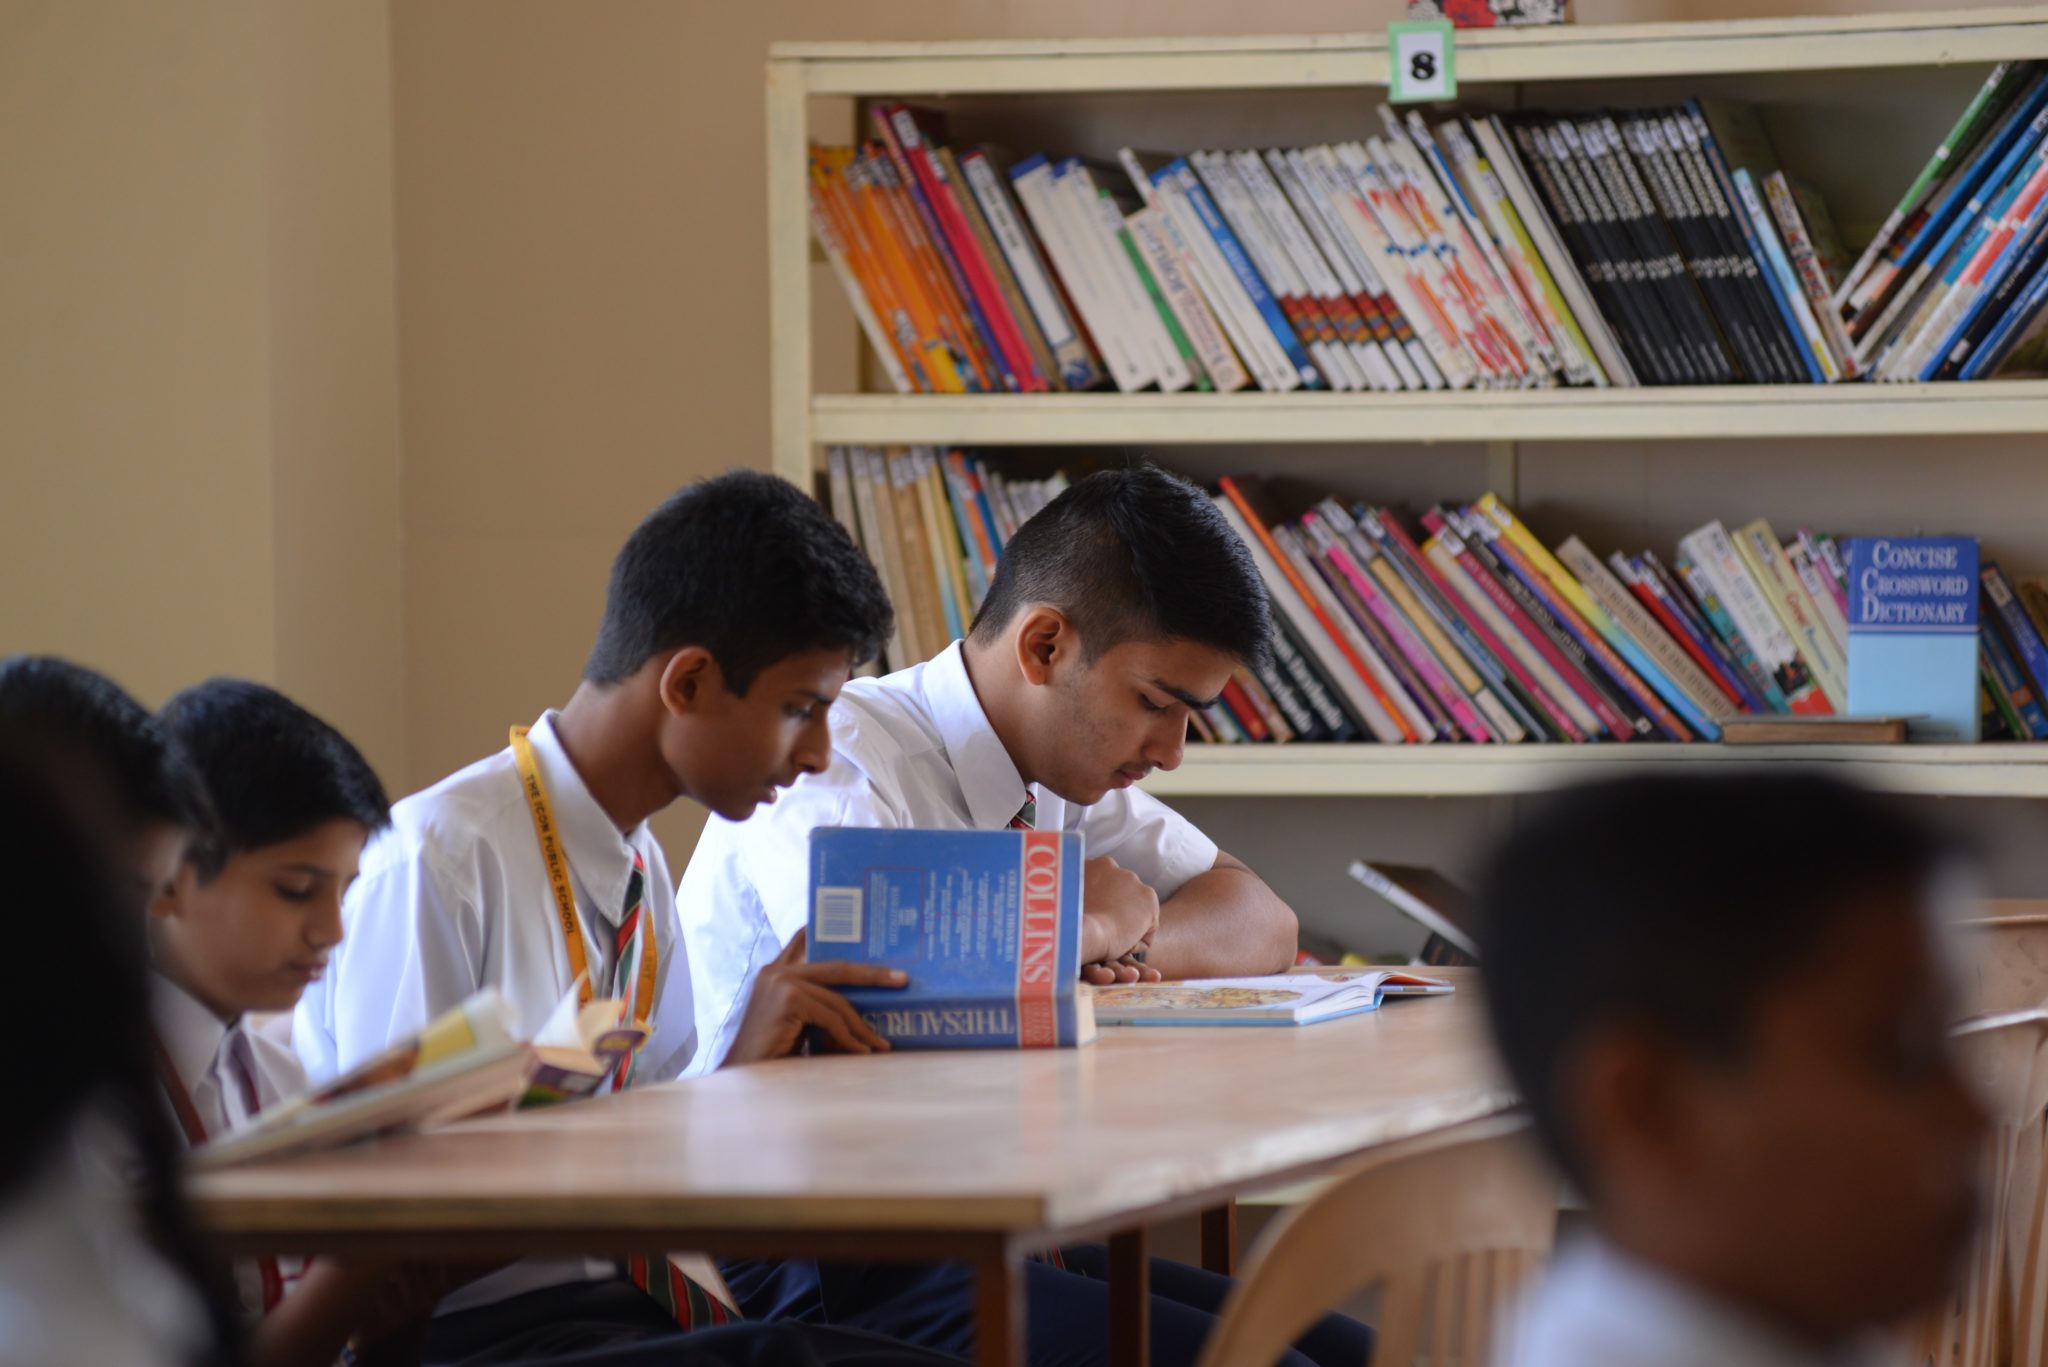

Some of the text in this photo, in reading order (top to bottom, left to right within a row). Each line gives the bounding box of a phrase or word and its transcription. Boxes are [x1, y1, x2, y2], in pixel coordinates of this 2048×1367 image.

[1411, 52, 1436, 80] 8
[1872, 539, 1958, 570] CONCISE
[1861, 566, 1969, 596] CROSSWORD
[1861, 592, 1968, 623] DICTIONARY
[526, 774, 575, 936] THE ICON PUBLIC SCHOOL
[1022, 844, 1057, 984] COLLINS
